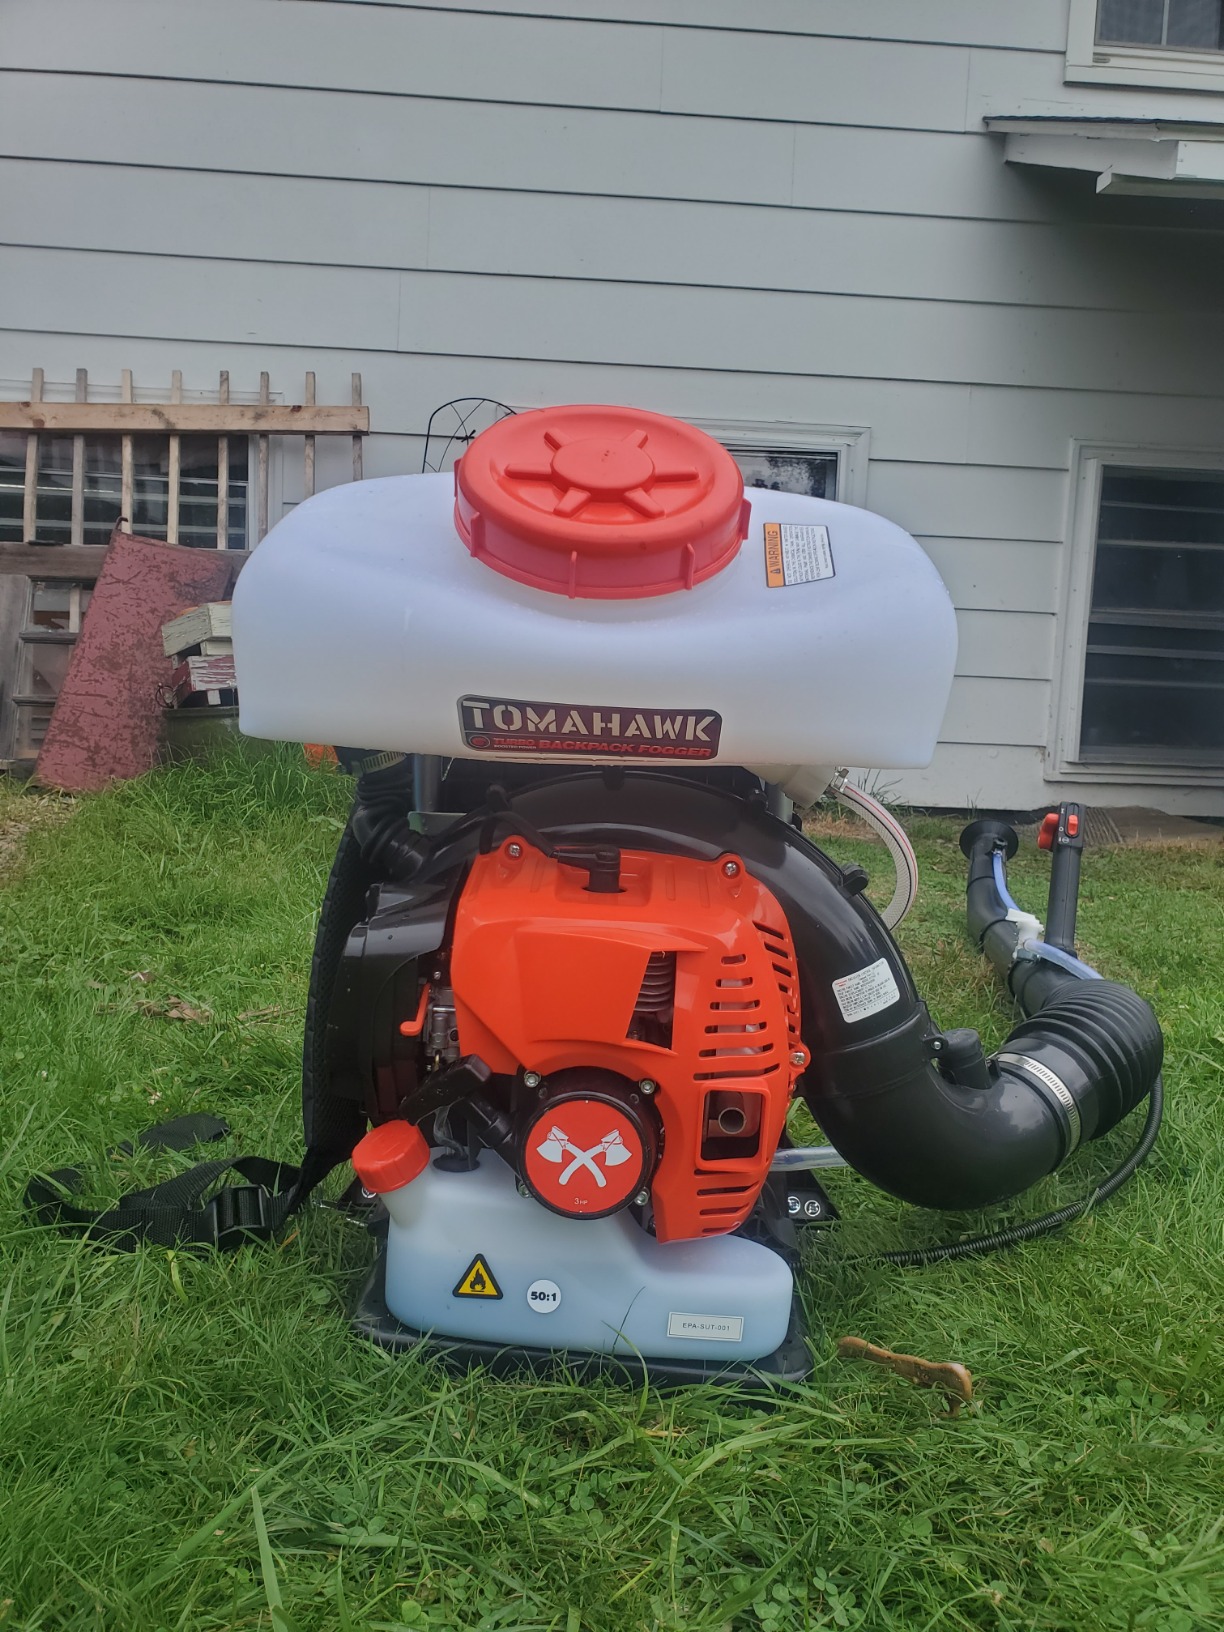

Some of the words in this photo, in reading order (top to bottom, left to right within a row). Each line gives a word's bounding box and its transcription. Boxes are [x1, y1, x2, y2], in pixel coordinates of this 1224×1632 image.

[767, 530, 780, 568] WARNING
[463, 700, 716, 741] TOMAHAWK
[493, 737, 536, 746] TURBO
[538, 739, 636, 752] BACKPACK
[638, 745, 712, 757] FOGGER
[530, 1291, 557, 1302] 50:1
[682, 1322, 731, 1331] EPA-SUT-001
